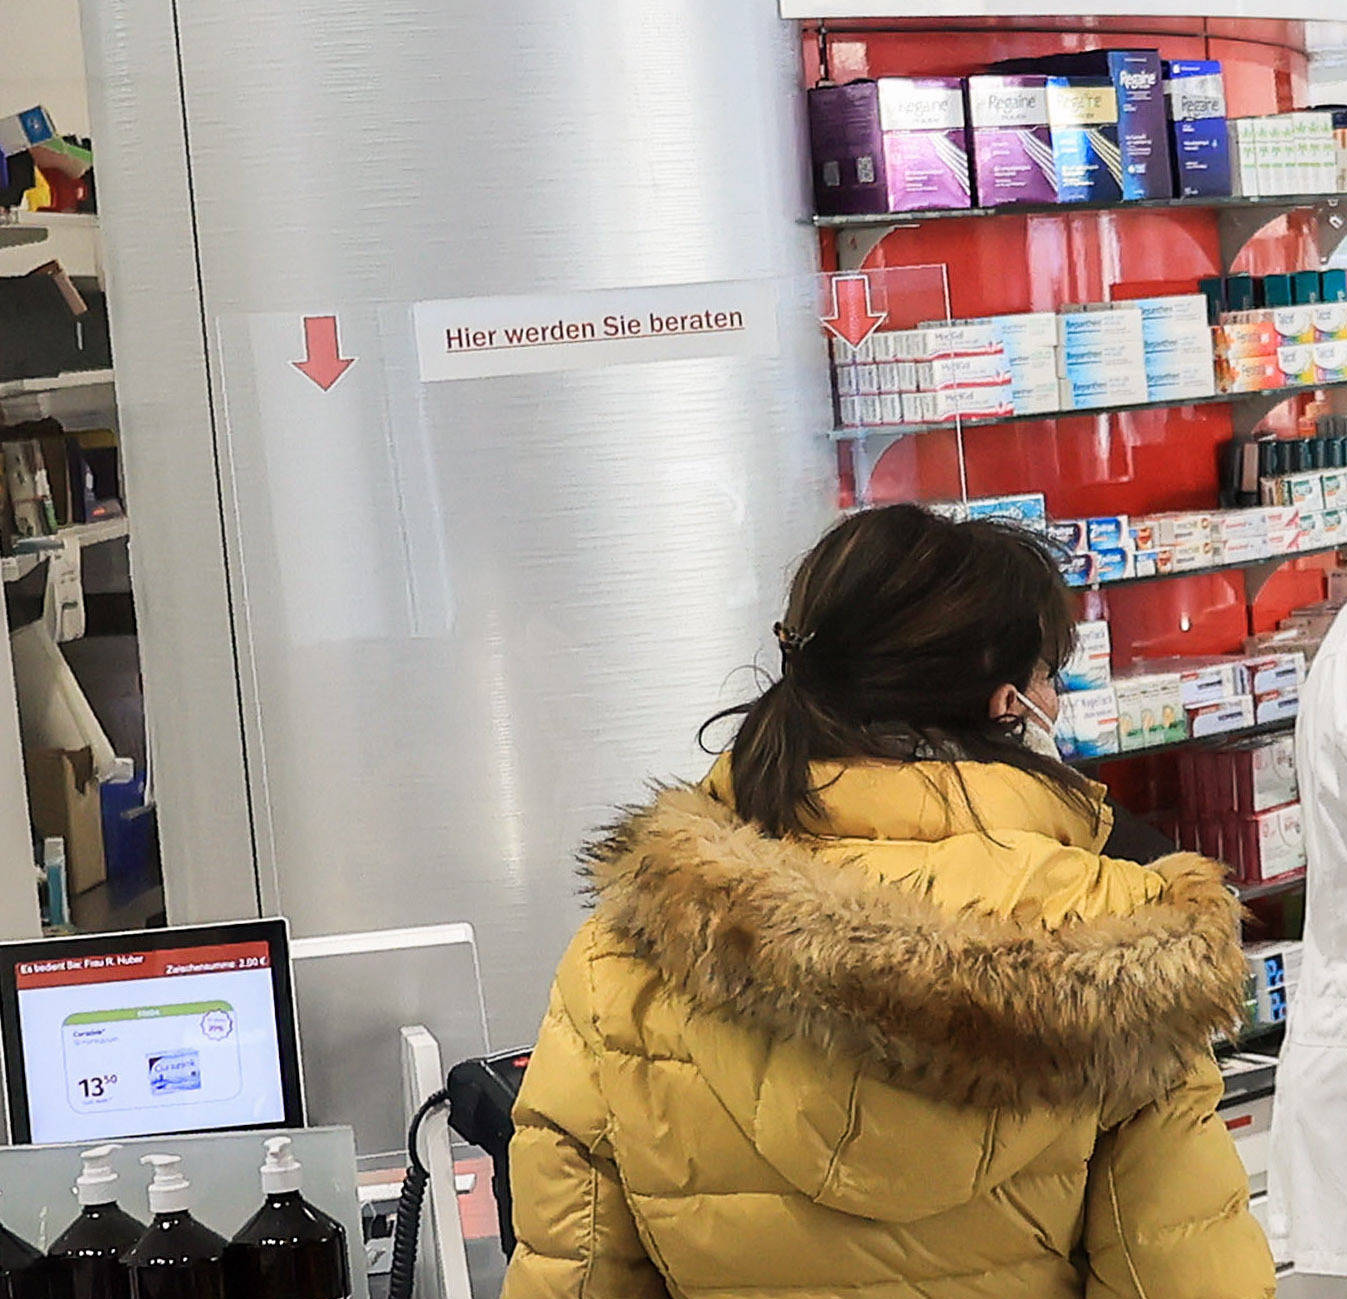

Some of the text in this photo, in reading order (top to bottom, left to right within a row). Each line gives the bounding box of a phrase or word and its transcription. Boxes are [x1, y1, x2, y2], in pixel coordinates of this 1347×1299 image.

[445, 306, 743, 351] Hier werden Sie beraten
[20, 964, 34, 974] Es
